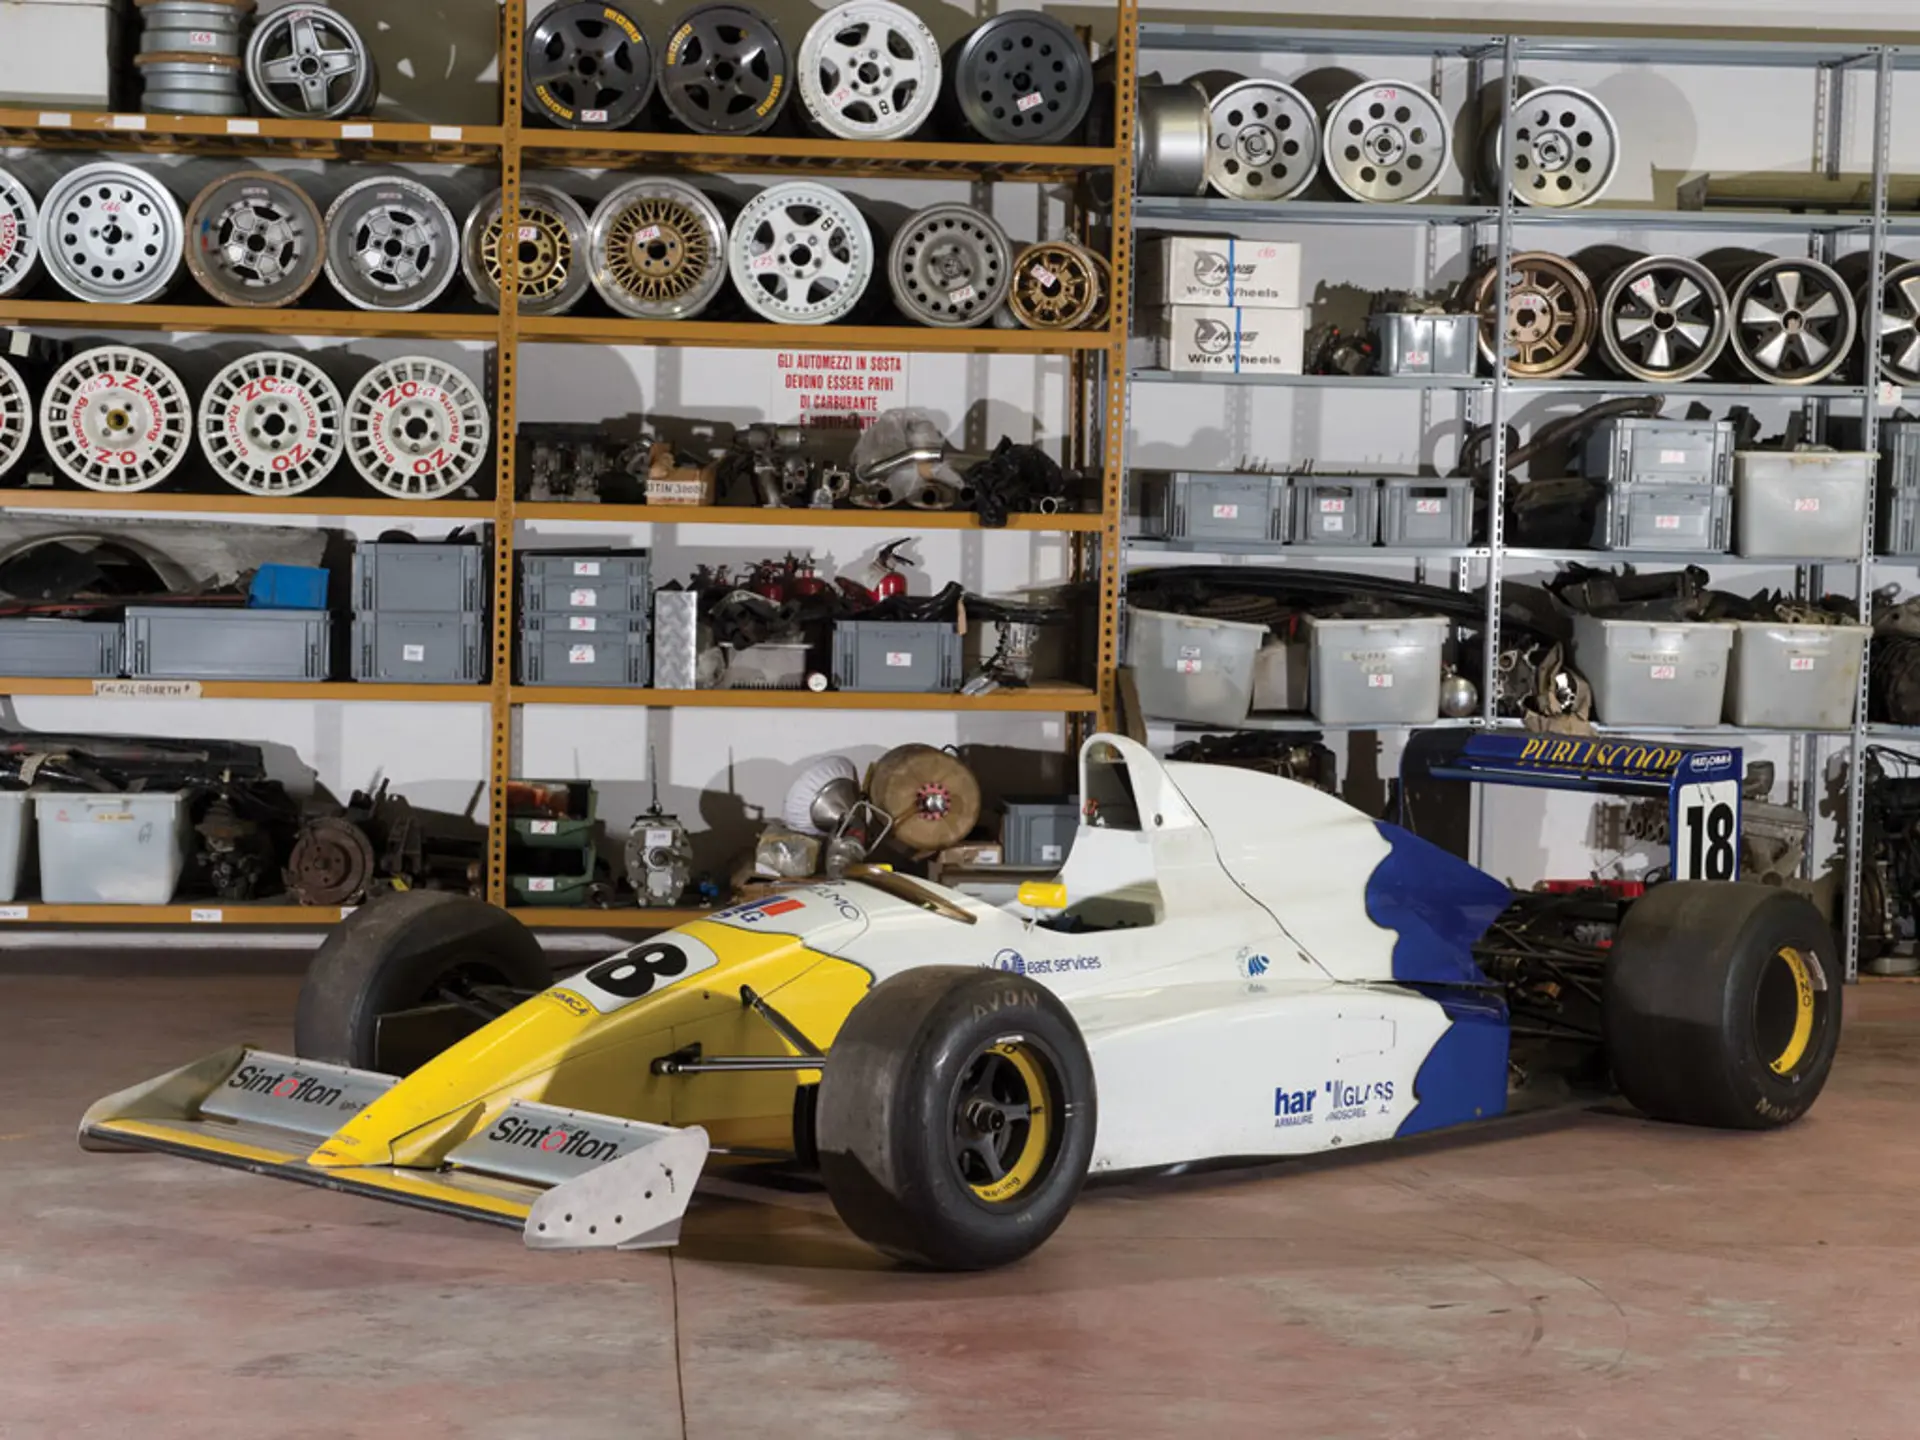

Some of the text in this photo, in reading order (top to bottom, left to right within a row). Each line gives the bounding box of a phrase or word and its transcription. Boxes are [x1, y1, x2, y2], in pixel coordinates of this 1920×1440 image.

[777, 353, 902, 372] GLI AUTOMEZZI IN SOSTA
[1188, 353, 1281, 365] Wire Wheels
[785, 374, 893, 391] DEVONO ESSERE PRIVI
[800, 395, 878, 411] DI CARBURANTE
[1687, 803, 1734, 881] 18
[1027, 955, 1101, 974] east services
[972, 988, 1039, 1023] AVON
[229, 1066, 342, 1106] Sintoflon
[489, 1117, 618, 1162] Sintoflon
